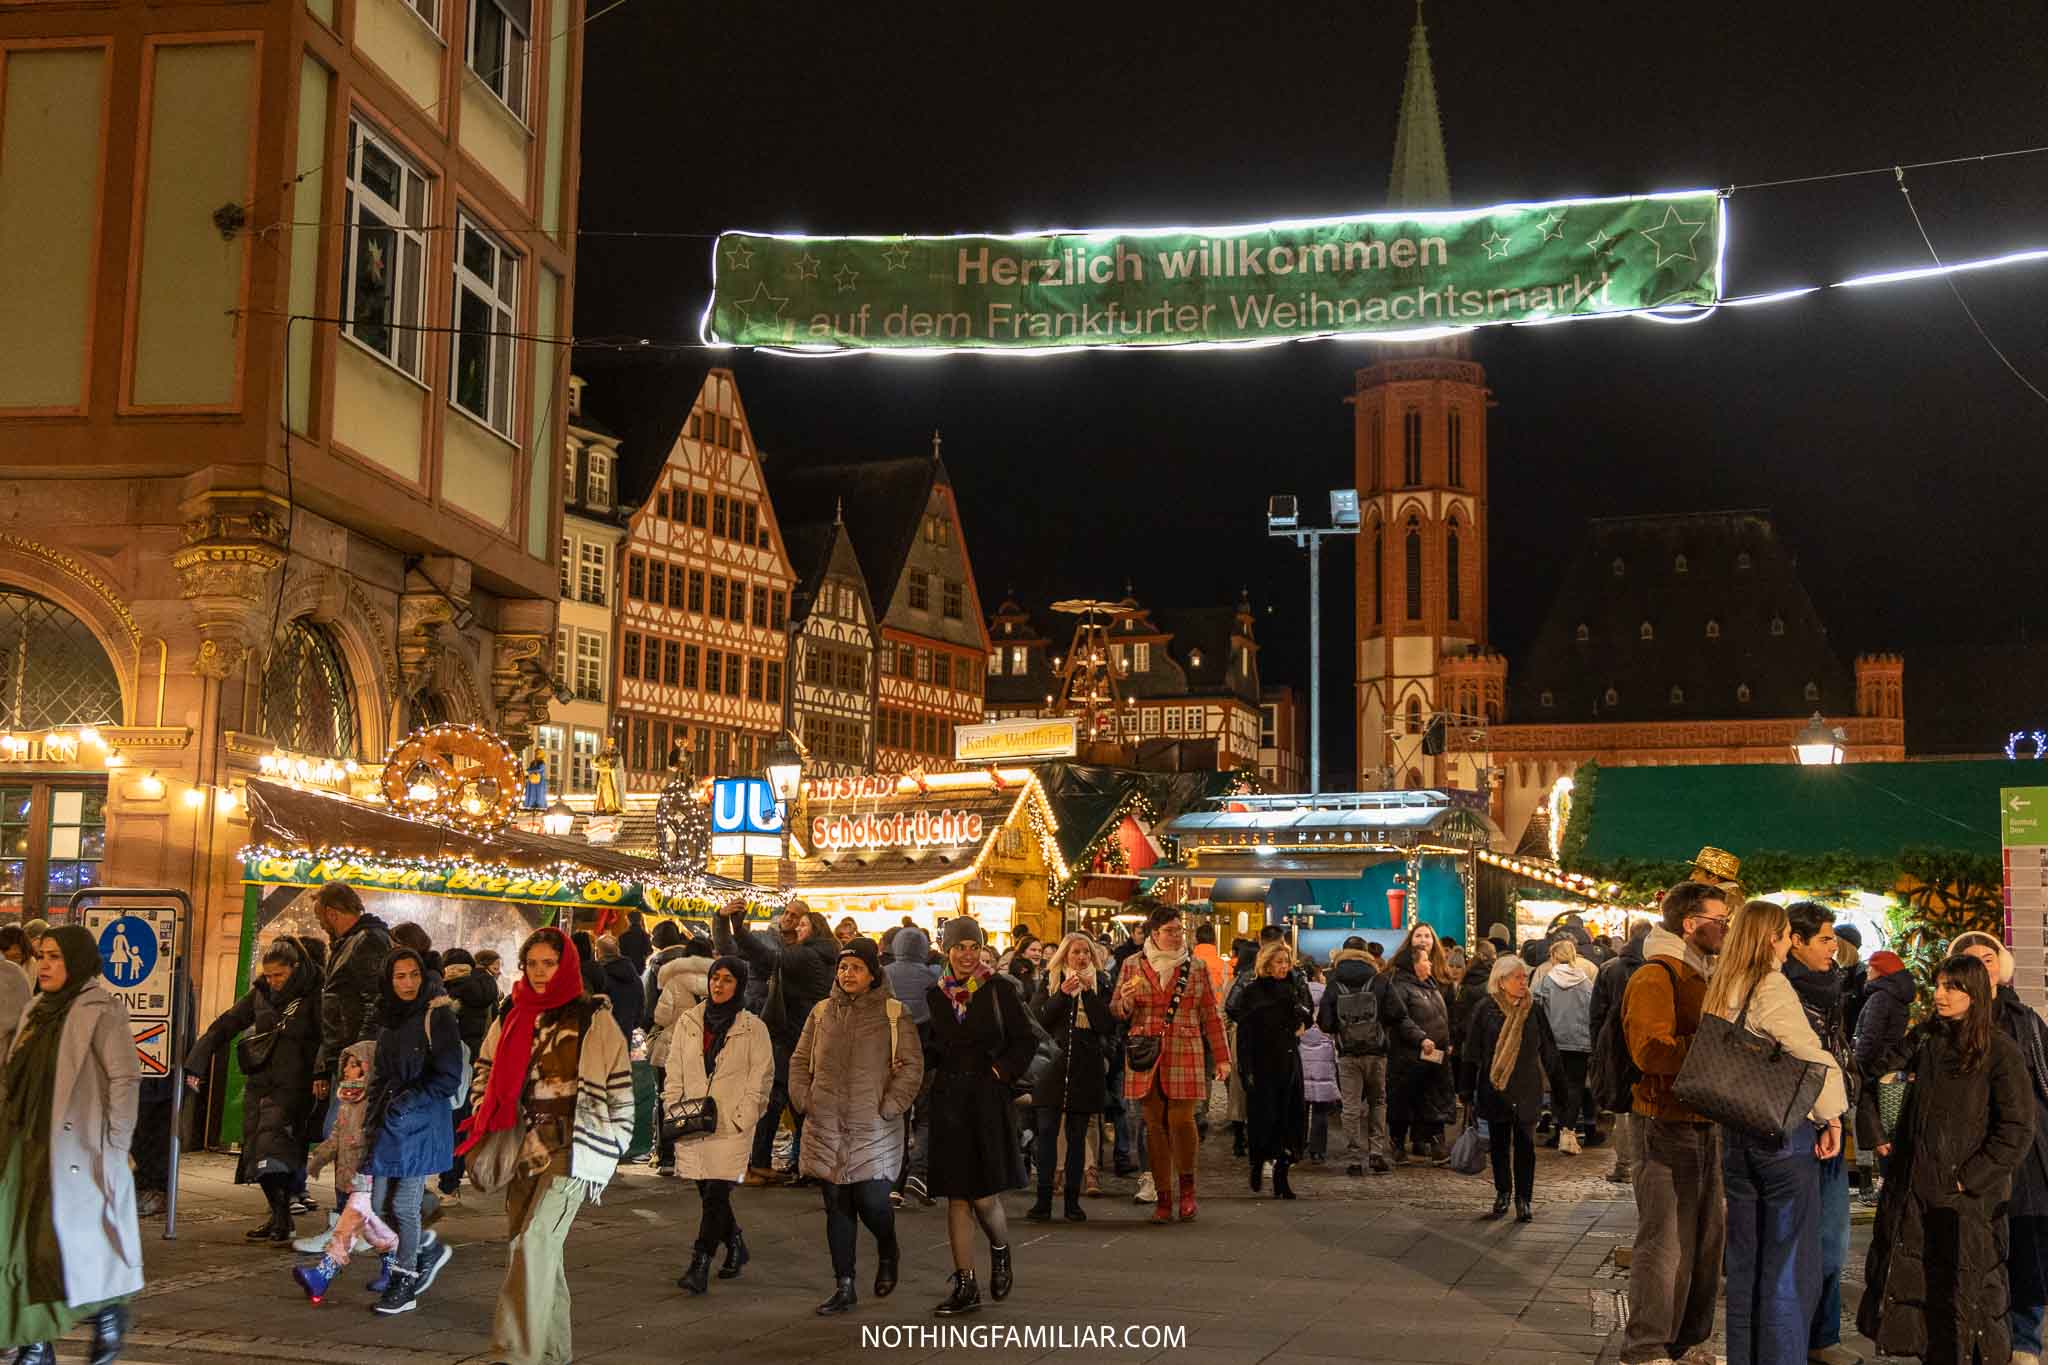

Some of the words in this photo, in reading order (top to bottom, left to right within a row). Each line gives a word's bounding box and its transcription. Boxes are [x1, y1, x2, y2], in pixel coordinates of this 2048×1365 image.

[957, 243, 1143, 287] Herzlich
[1159, 235, 1448, 280] willkommen
[809, 303, 871, 338] auf
[882, 303, 971, 338] dem
[986, 299, 1217, 338] Frankfurter
[1230, 271, 1613, 330] Weihnachtsmarkt
[715, 783, 745, 830] U
[807, 775, 899, 799] ALTSTADT
[813, 809, 982, 847] Schokofrüchte
[108, 992, 148, 1010] ONE
